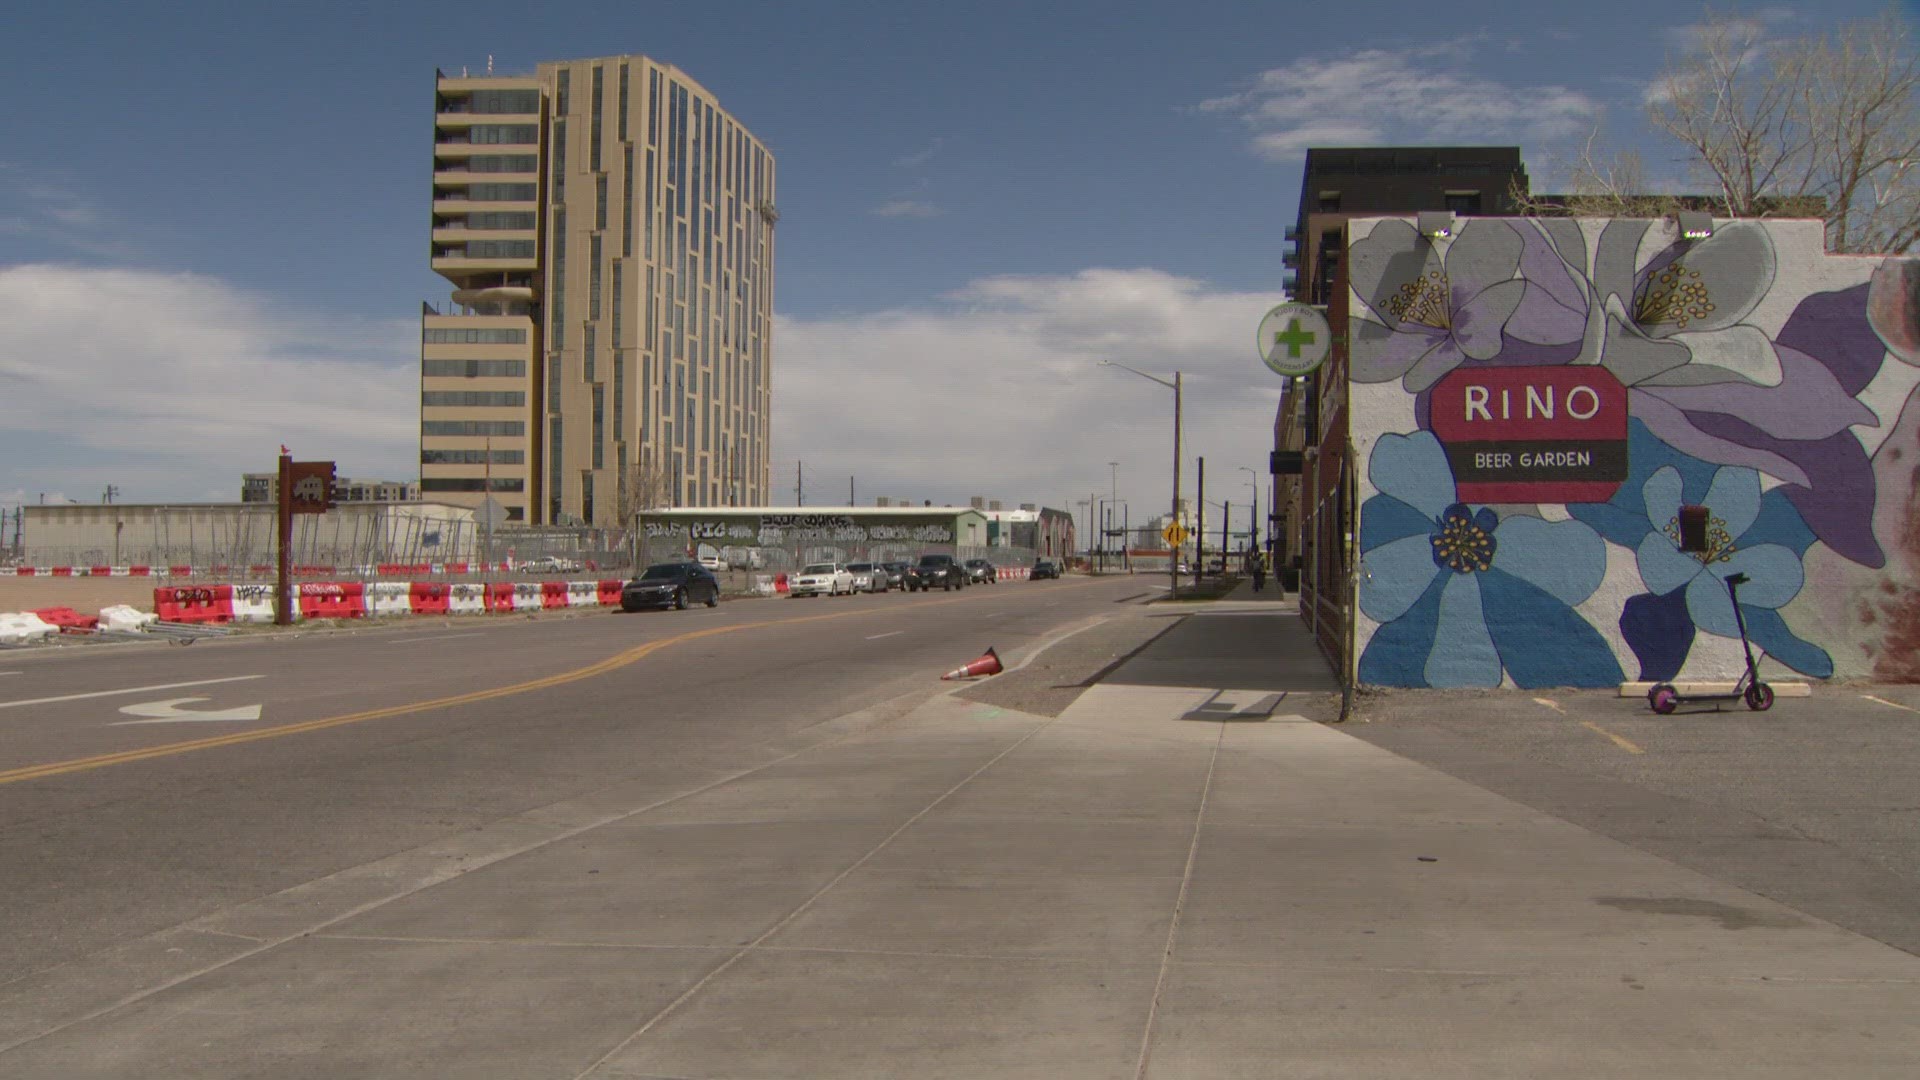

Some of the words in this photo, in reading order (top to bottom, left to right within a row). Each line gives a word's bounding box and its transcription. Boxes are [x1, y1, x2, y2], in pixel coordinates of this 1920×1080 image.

[1465, 385, 1600, 421] RINO
[1475, 453, 1512, 468] BEER
[1519, 451, 1590, 467] GARDEN
